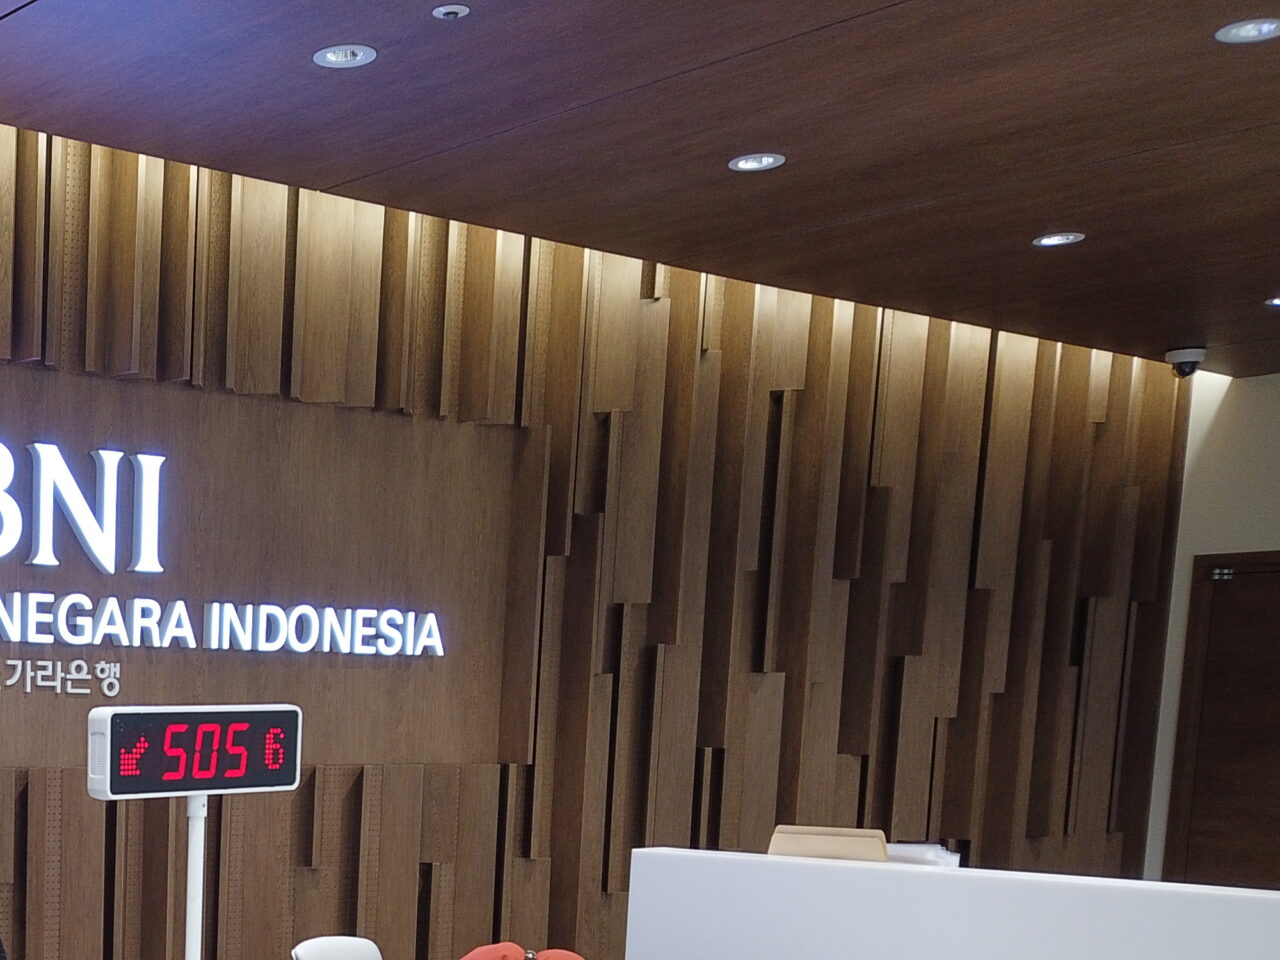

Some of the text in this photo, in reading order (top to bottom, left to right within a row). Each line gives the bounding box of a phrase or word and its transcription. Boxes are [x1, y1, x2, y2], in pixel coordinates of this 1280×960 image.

[207, 602, 445, 657] INDONESIA
[162, 722, 285, 781] 505 6
